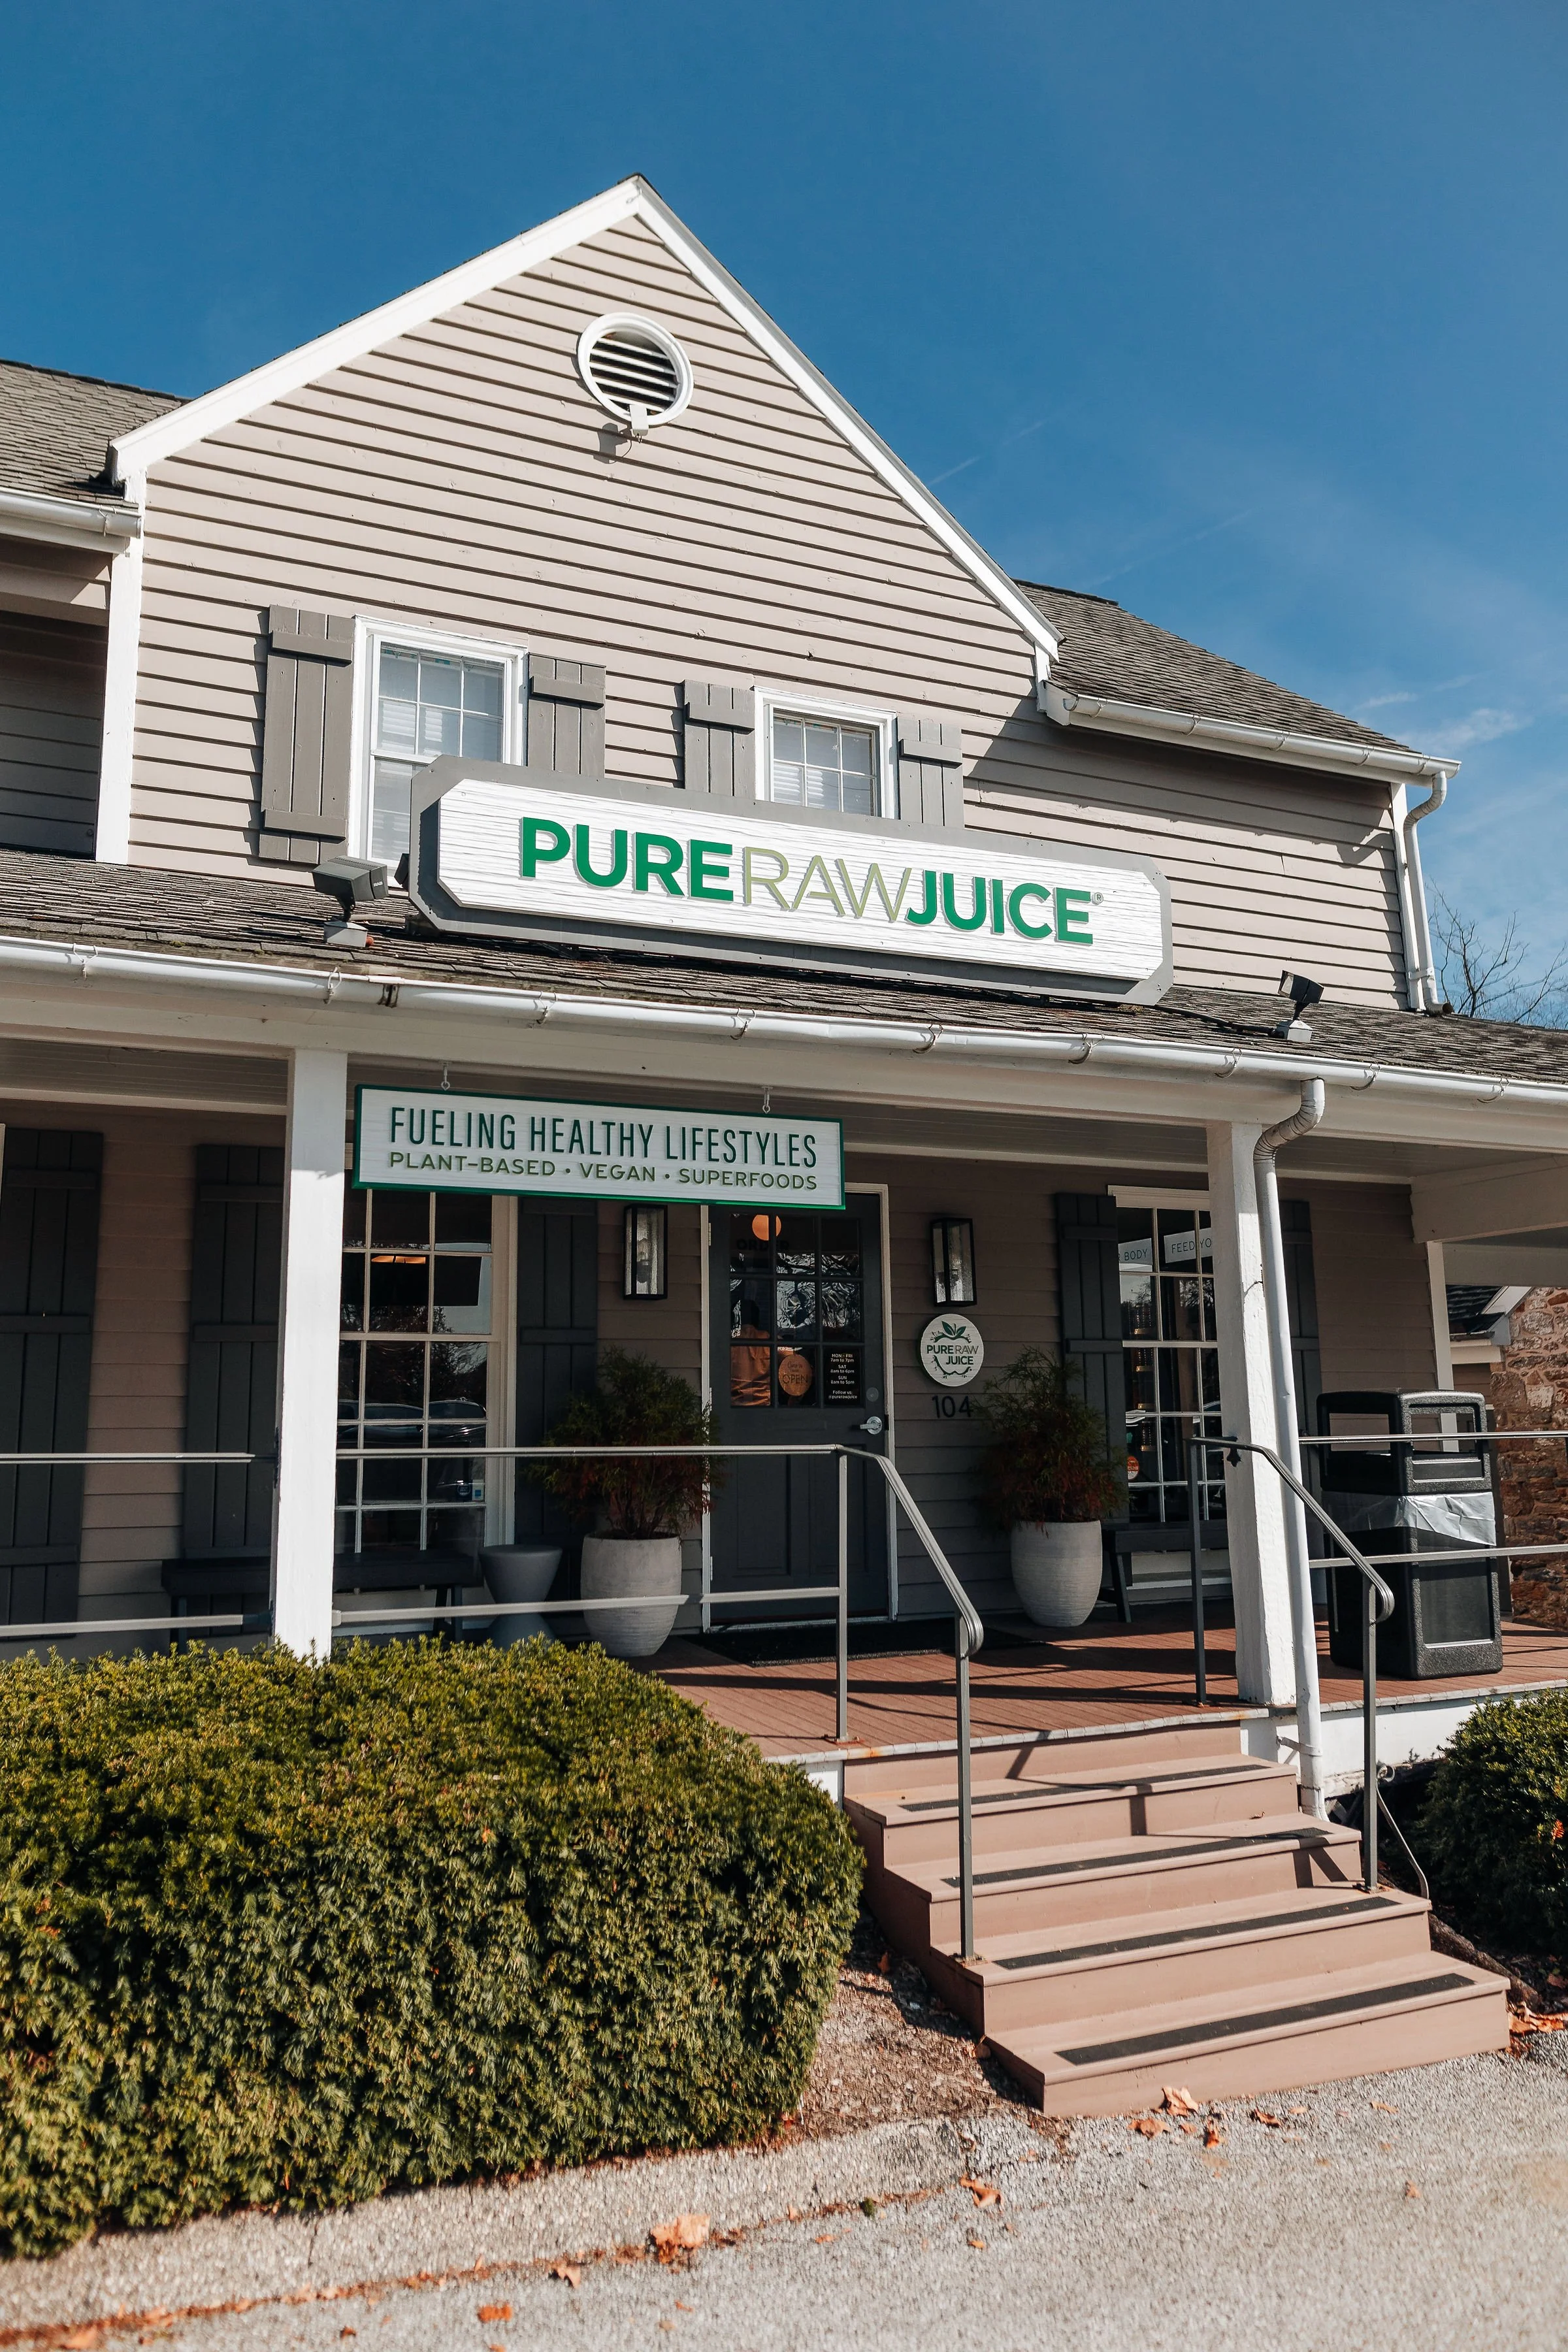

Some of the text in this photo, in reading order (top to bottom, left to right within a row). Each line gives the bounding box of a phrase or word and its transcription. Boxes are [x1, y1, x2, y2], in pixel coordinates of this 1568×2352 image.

[390, 1107, 818, 1168] FUELING HEALTHY LIFESTYLES
[390, 1151, 818, 1191] PLANT-BASED VEGAN SUPERFOODS
[1171, 1241, 1195, 1254] FEED
[1124, 1249, 1148, 1261] BODY
[945, 1356, 974, 1365] JUICE
[782, 1374, 808, 1384] OPEN
[932, 1395, 972, 1418] 104
